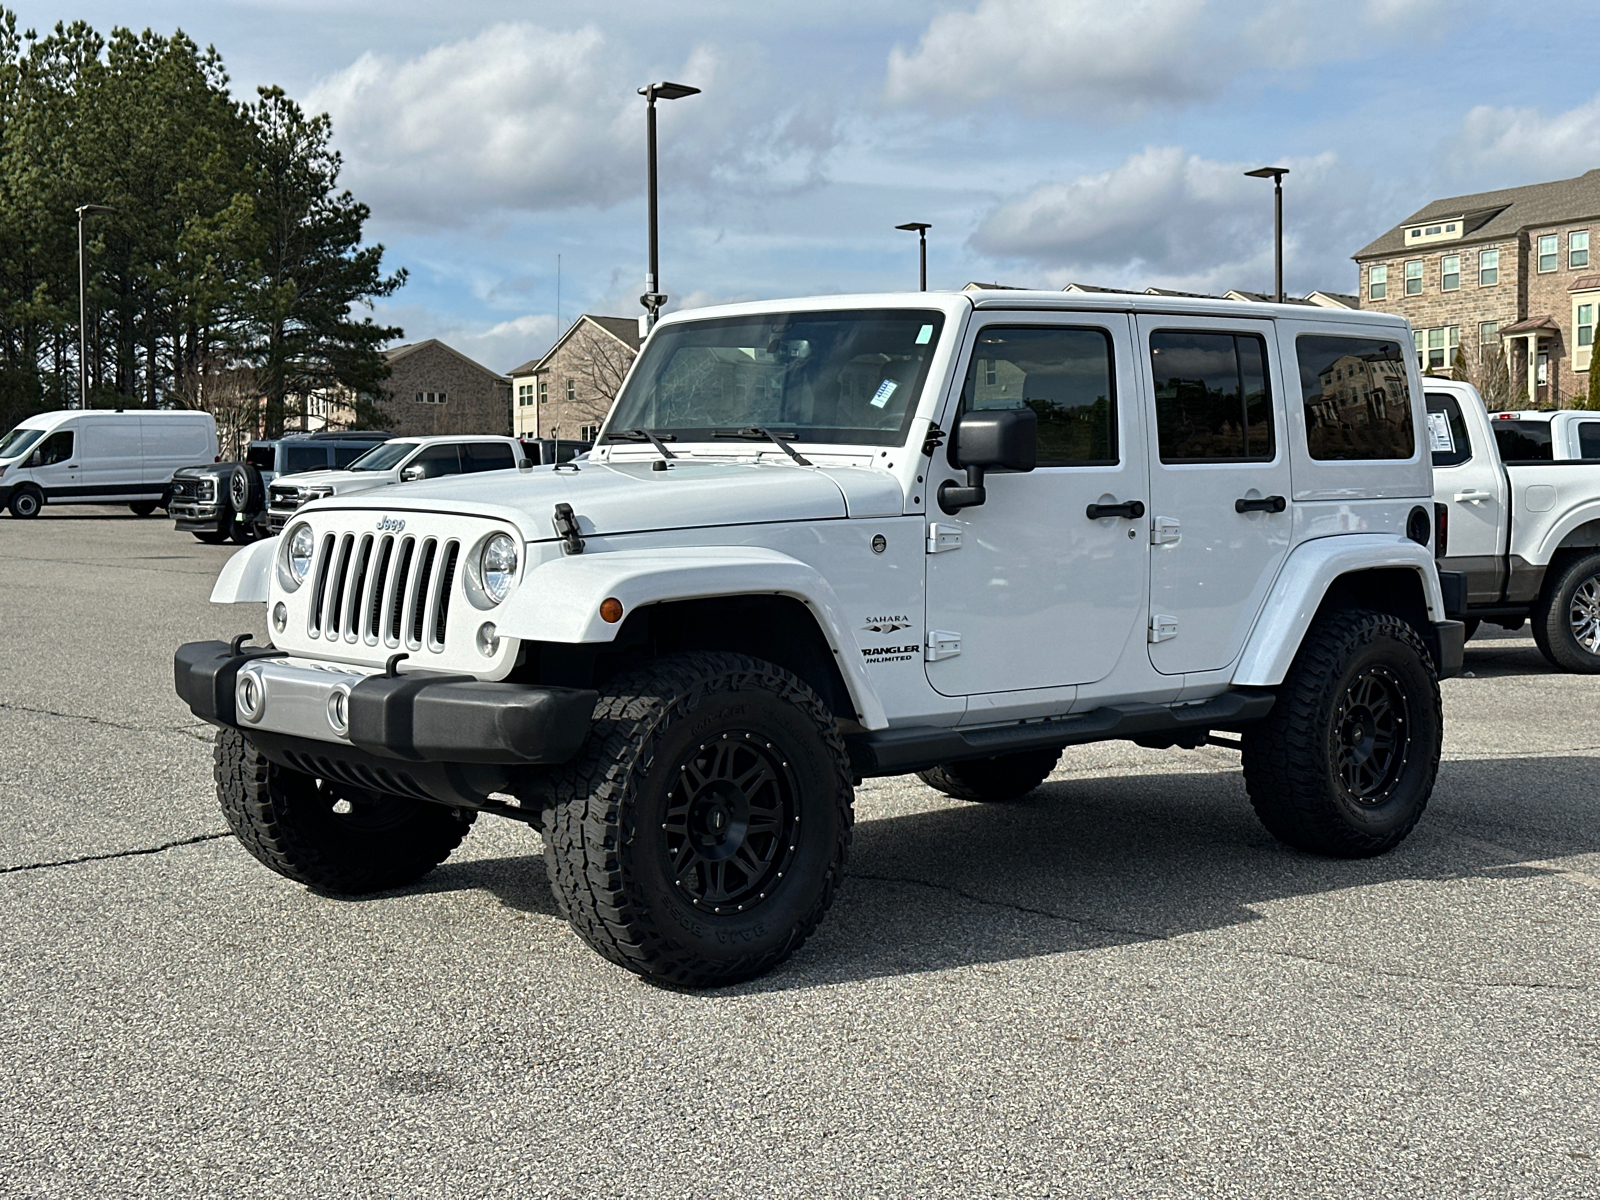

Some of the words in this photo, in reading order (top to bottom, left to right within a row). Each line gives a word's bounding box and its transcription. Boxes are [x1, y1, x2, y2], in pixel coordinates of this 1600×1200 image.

[376, 514, 406, 535] Jeep
[865, 615, 909, 623] SAHARA
[861, 645, 920, 656] RANGLER
